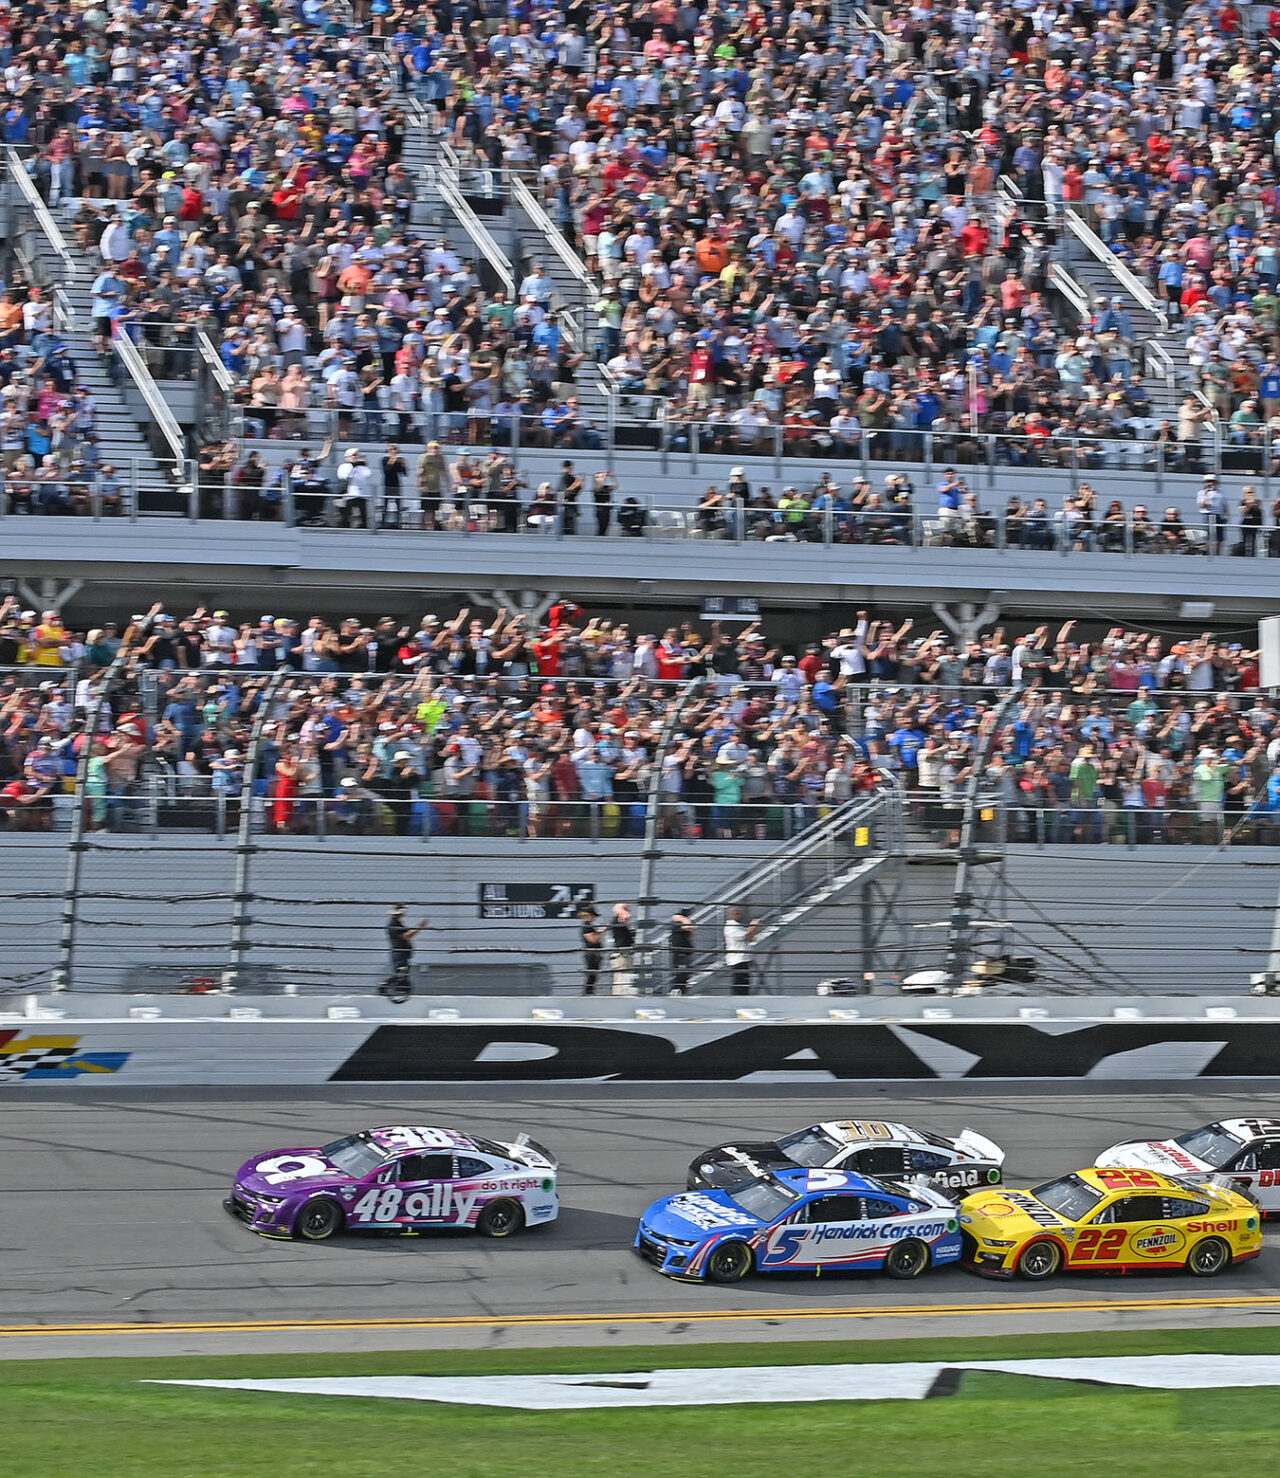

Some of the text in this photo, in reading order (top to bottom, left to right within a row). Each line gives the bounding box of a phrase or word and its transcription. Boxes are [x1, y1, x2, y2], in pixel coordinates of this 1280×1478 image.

[836, 1121, 893, 1142] 10
[481, 1181, 498, 1190] do
[500, 1180, 509, 1190] it
[806, 1168, 849, 1191] 5
[1096, 1169, 1161, 1190] 22
[353, 1189, 403, 1221] 48
[405, 1183, 480, 1224] ally
[1186, 1220, 1238, 1233] Shell
[762, 1230, 811, 1266] 5
[1073, 1229, 1128, 1260] 22
[1137, 1234, 1178, 1249] PENNZOIL
